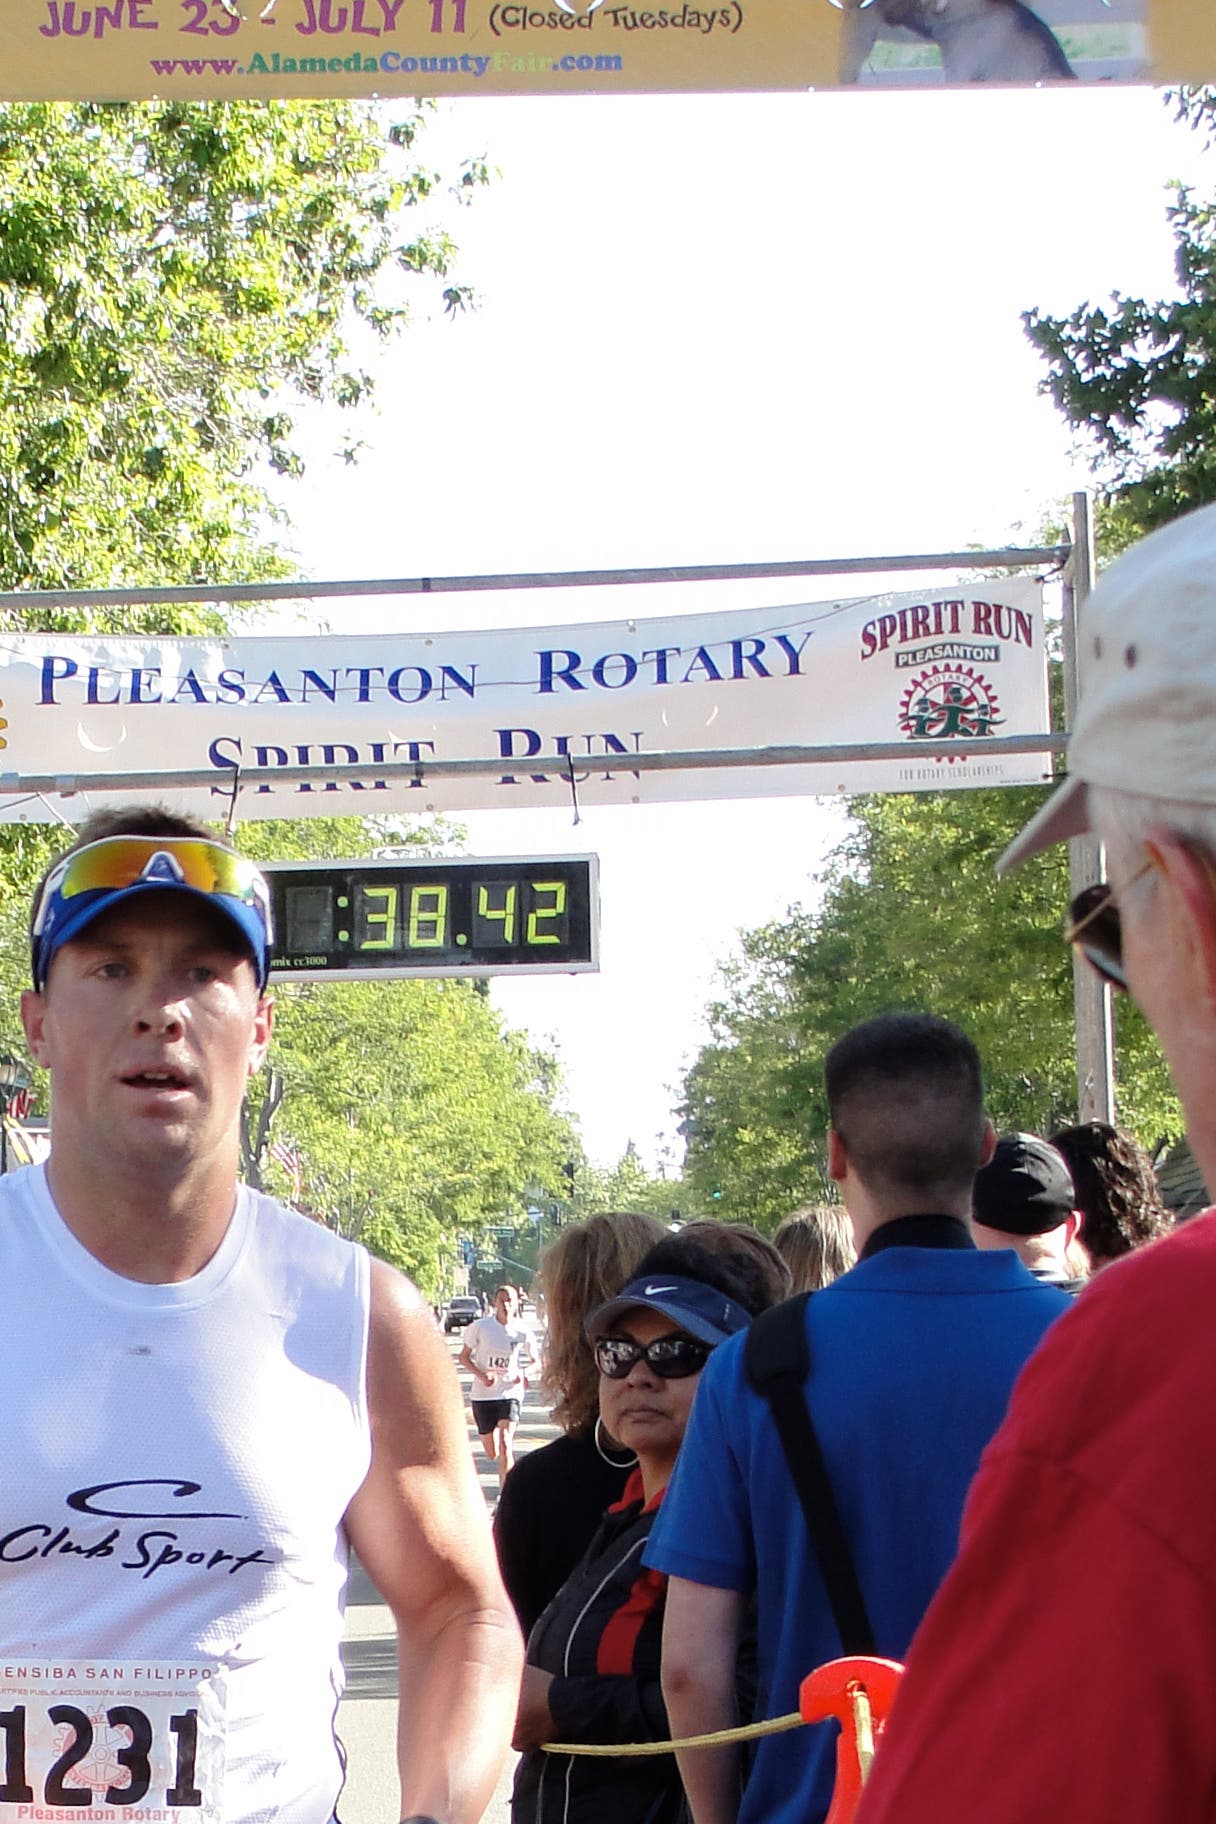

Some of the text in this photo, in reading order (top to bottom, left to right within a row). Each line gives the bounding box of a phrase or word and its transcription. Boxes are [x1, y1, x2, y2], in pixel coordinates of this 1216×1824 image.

[38, 0, 159, 39] JUNE
[179, 0, 241, 37] 23
[295, 0, 405, 37] JULY
[430, 0, 466, 33] 11
[489, 2, 592, 36] (Closed
[604, 2, 743, 34] Tuesdays)
[150, 51, 623, 77] www.AlamedaCountyFair.com
[861, 600, 1033, 661] SPIRIT RUN
[898, 645, 996, 667] PLEASANTON
[35, 631, 817, 706] PLEASANTON ROTARY
[927, 673, 969, 686] ROTARY
[207, 728, 644, 797] SPIRIT RUN
[488, 1356, 510, 1368] 1420
[122, 1531, 275, 1578] Sport
[85, 1667, 125, 1679] SAN
[134, 1668, 212, 1680] FILIPPO
[30, 1688, 58, 1697] PUBLIC
[59, 1689, 115, 1697] ACCOUNTANTS
[116, 1689, 133, 1697] AND
[17, 1806, 181, 1823] Pleasanton Rotary
